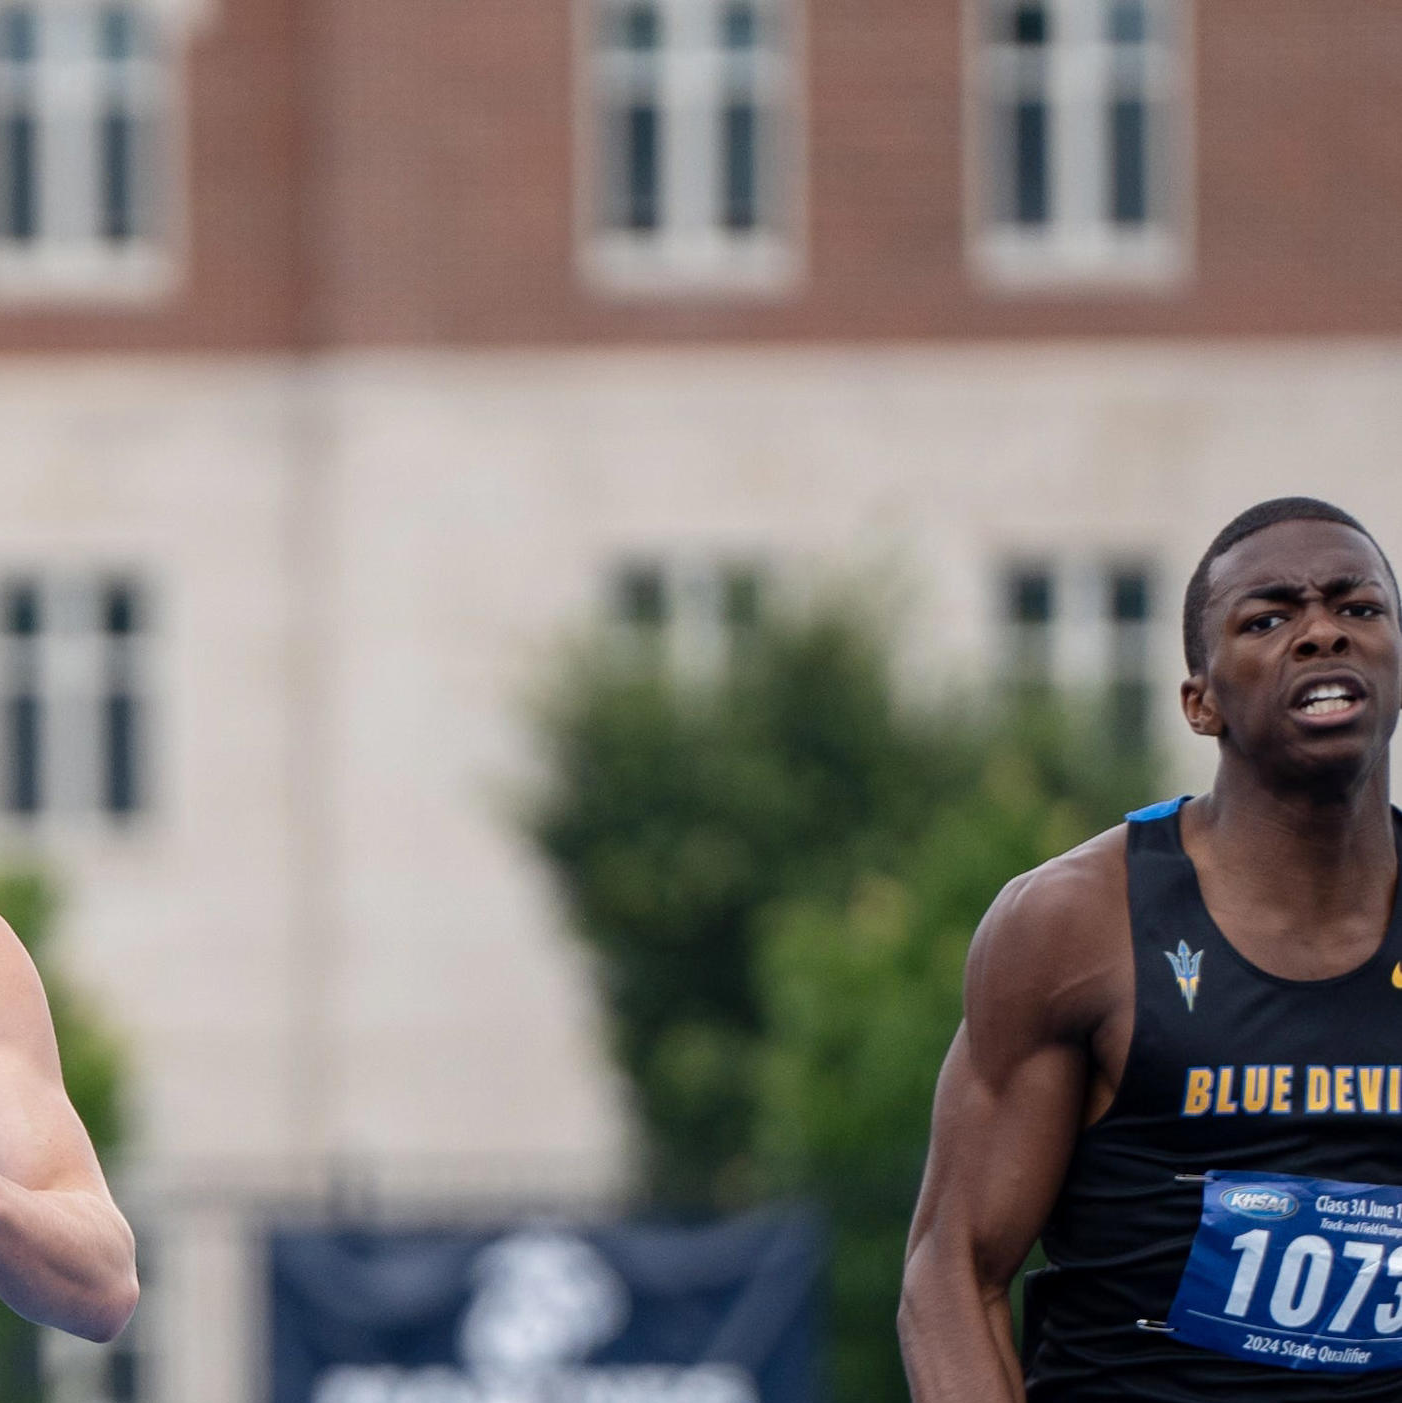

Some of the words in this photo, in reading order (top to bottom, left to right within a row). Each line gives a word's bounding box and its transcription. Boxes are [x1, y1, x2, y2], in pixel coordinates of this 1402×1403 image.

[1182, 1065, 1293, 1117] BLUE
[1305, 1065, 1402, 1116] DEVI
[1315, 1195, 1350, 1214] Class
[1349, 1199, 1367, 1216] 3A
[1367, 1200, 1395, 1219] June
[1223, 1228, 1402, 1335] 1073
[1243, 1334, 1280, 1353] 2024
[1280, 1340, 1316, 1360] State
[1317, 1345, 1372, 1364] Qualifier
